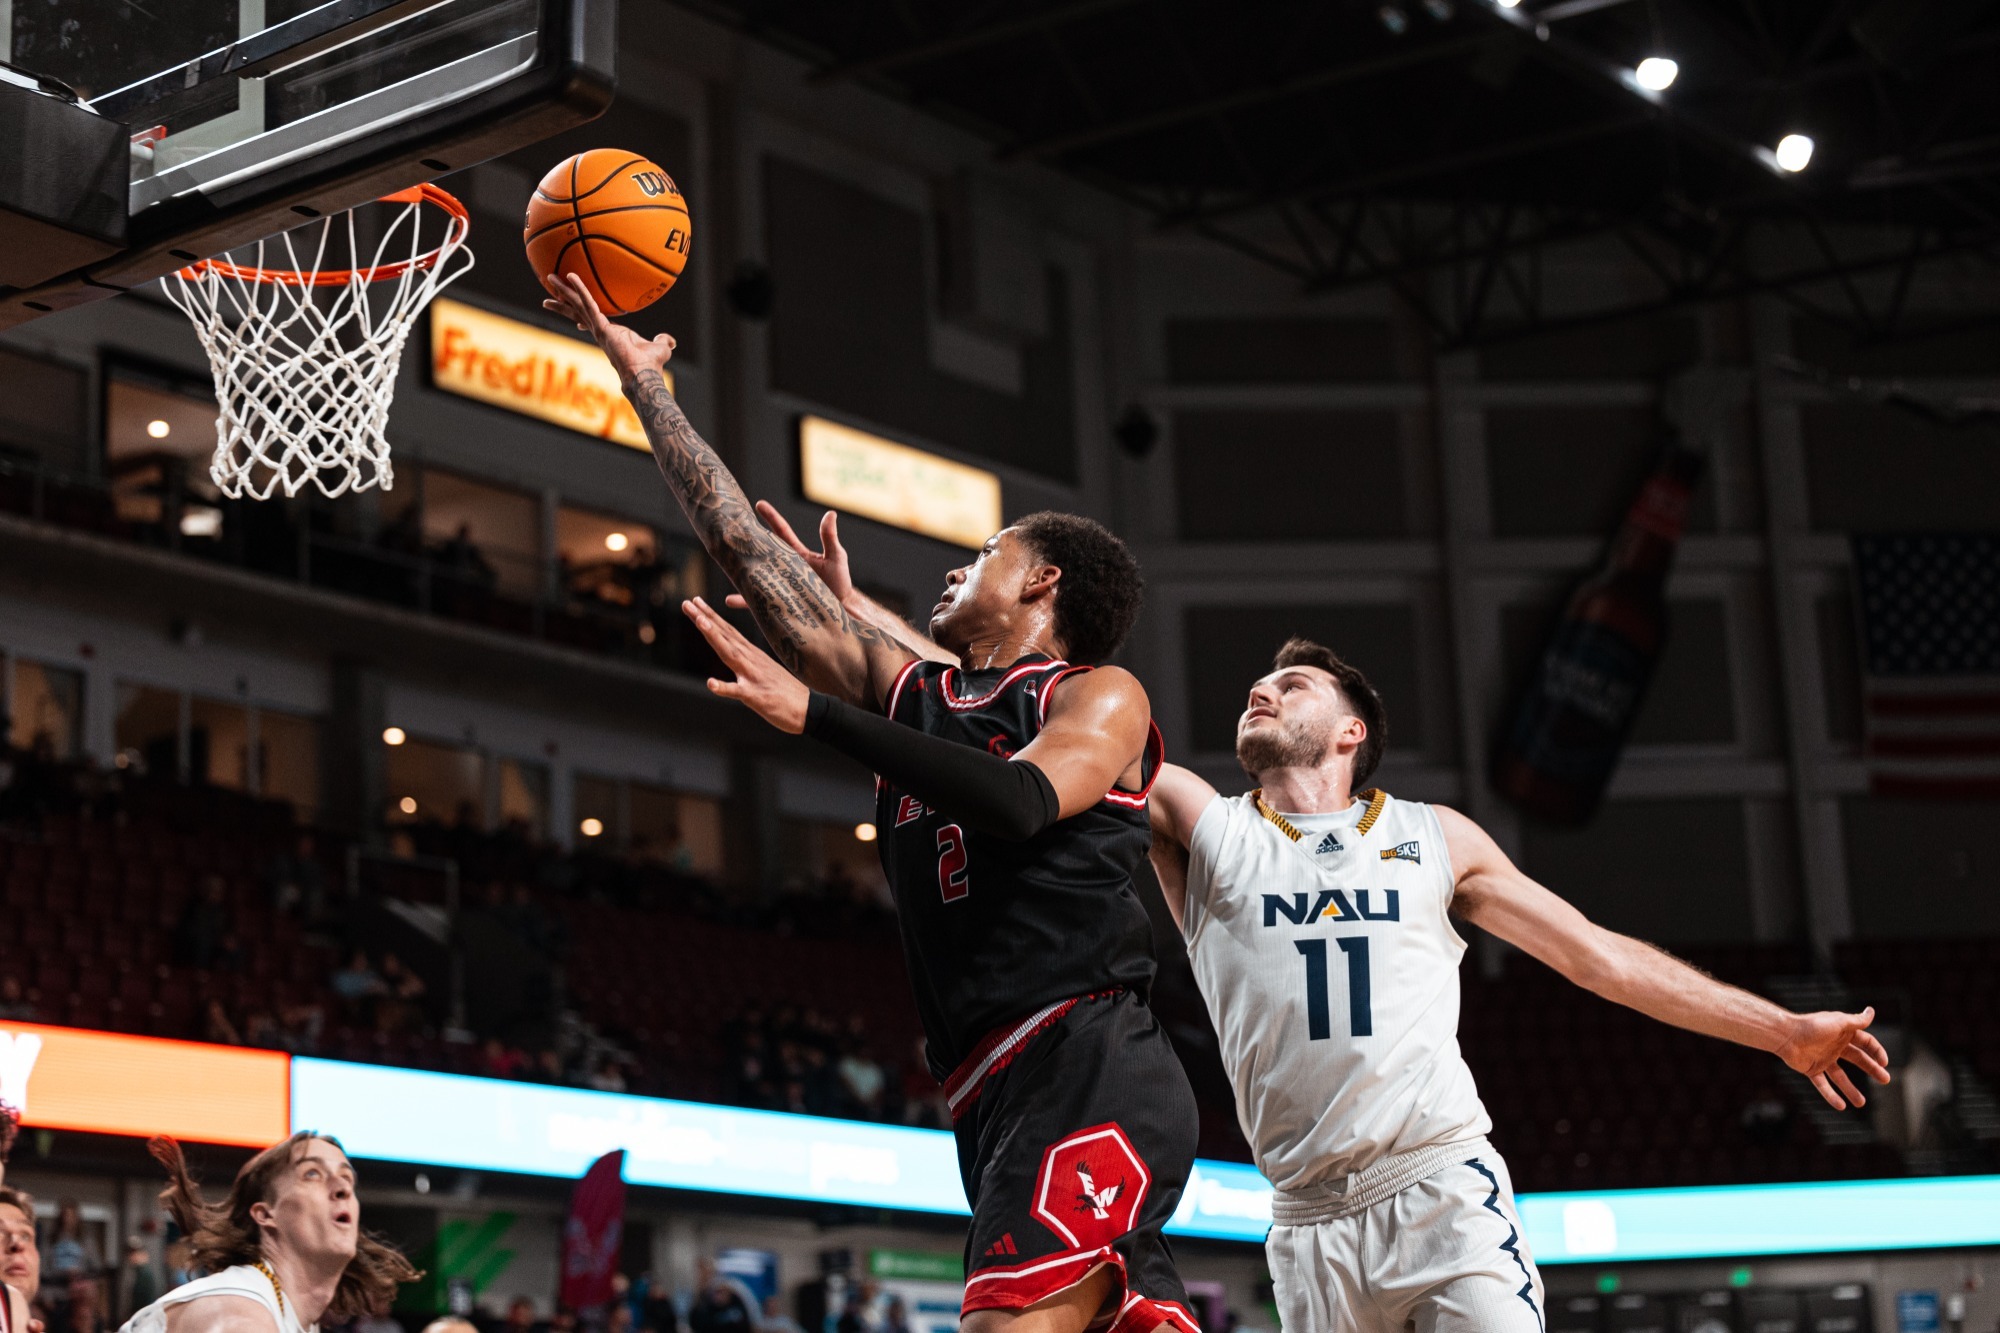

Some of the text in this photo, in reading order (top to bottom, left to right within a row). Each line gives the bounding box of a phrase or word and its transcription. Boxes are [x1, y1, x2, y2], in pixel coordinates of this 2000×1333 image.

[937, 823, 969, 904] 2
[1315, 843, 1344, 855] adidas
[1261, 889, 1400, 927] NAU
[1293, 936, 1373, 1041] 11
